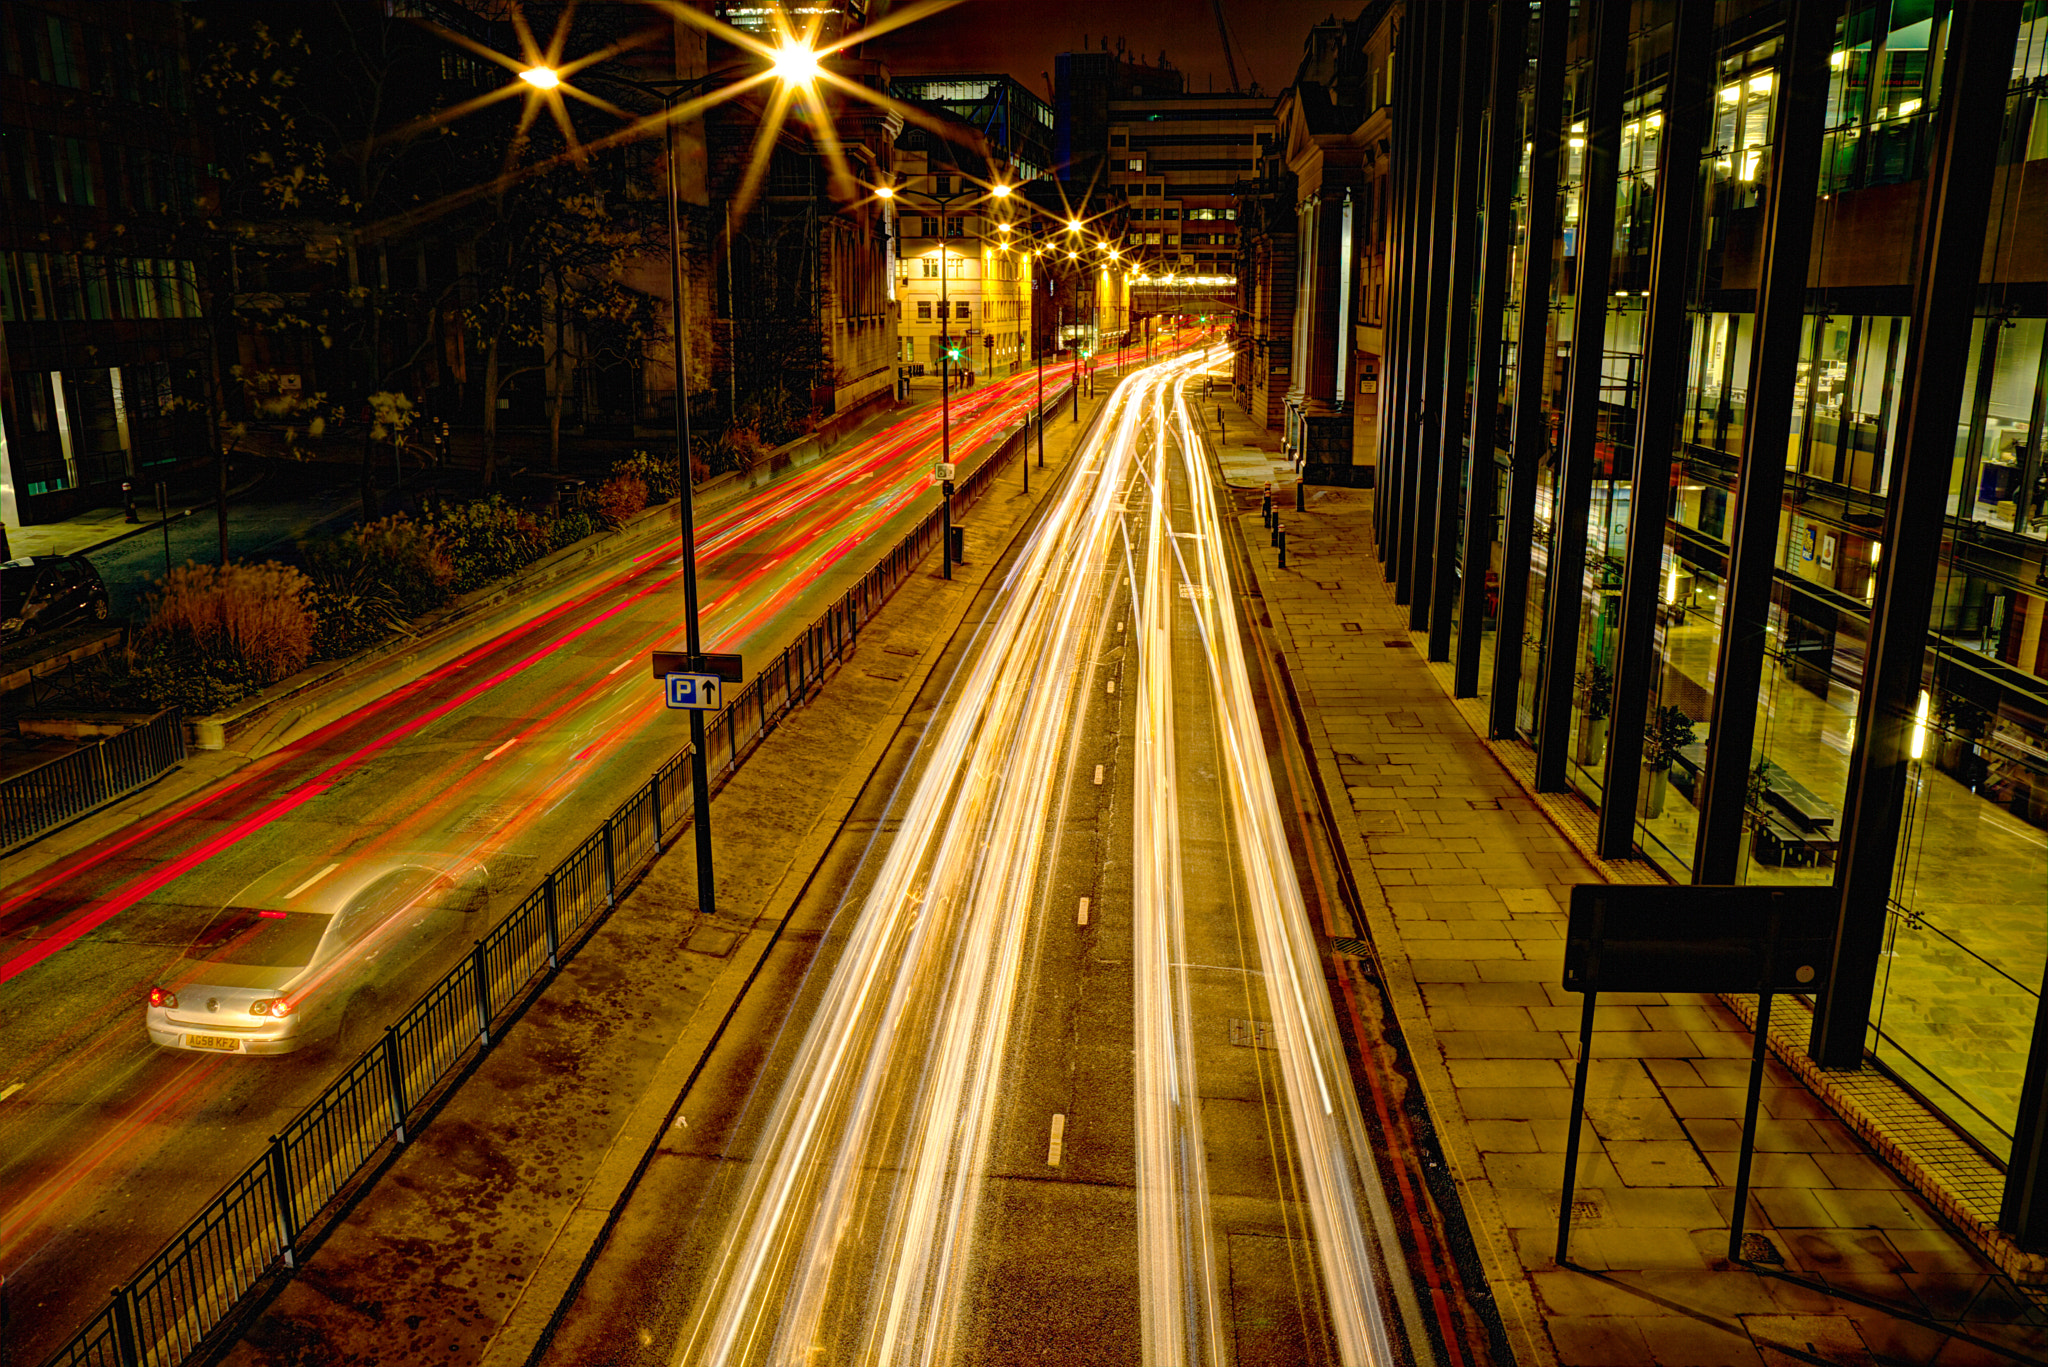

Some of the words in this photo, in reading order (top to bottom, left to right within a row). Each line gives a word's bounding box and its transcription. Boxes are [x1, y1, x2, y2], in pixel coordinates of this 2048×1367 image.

[676, 680, 692, 701] P
[190, 1035, 214, 1047] AG58
[216, 1037, 235, 1049] KFZ
